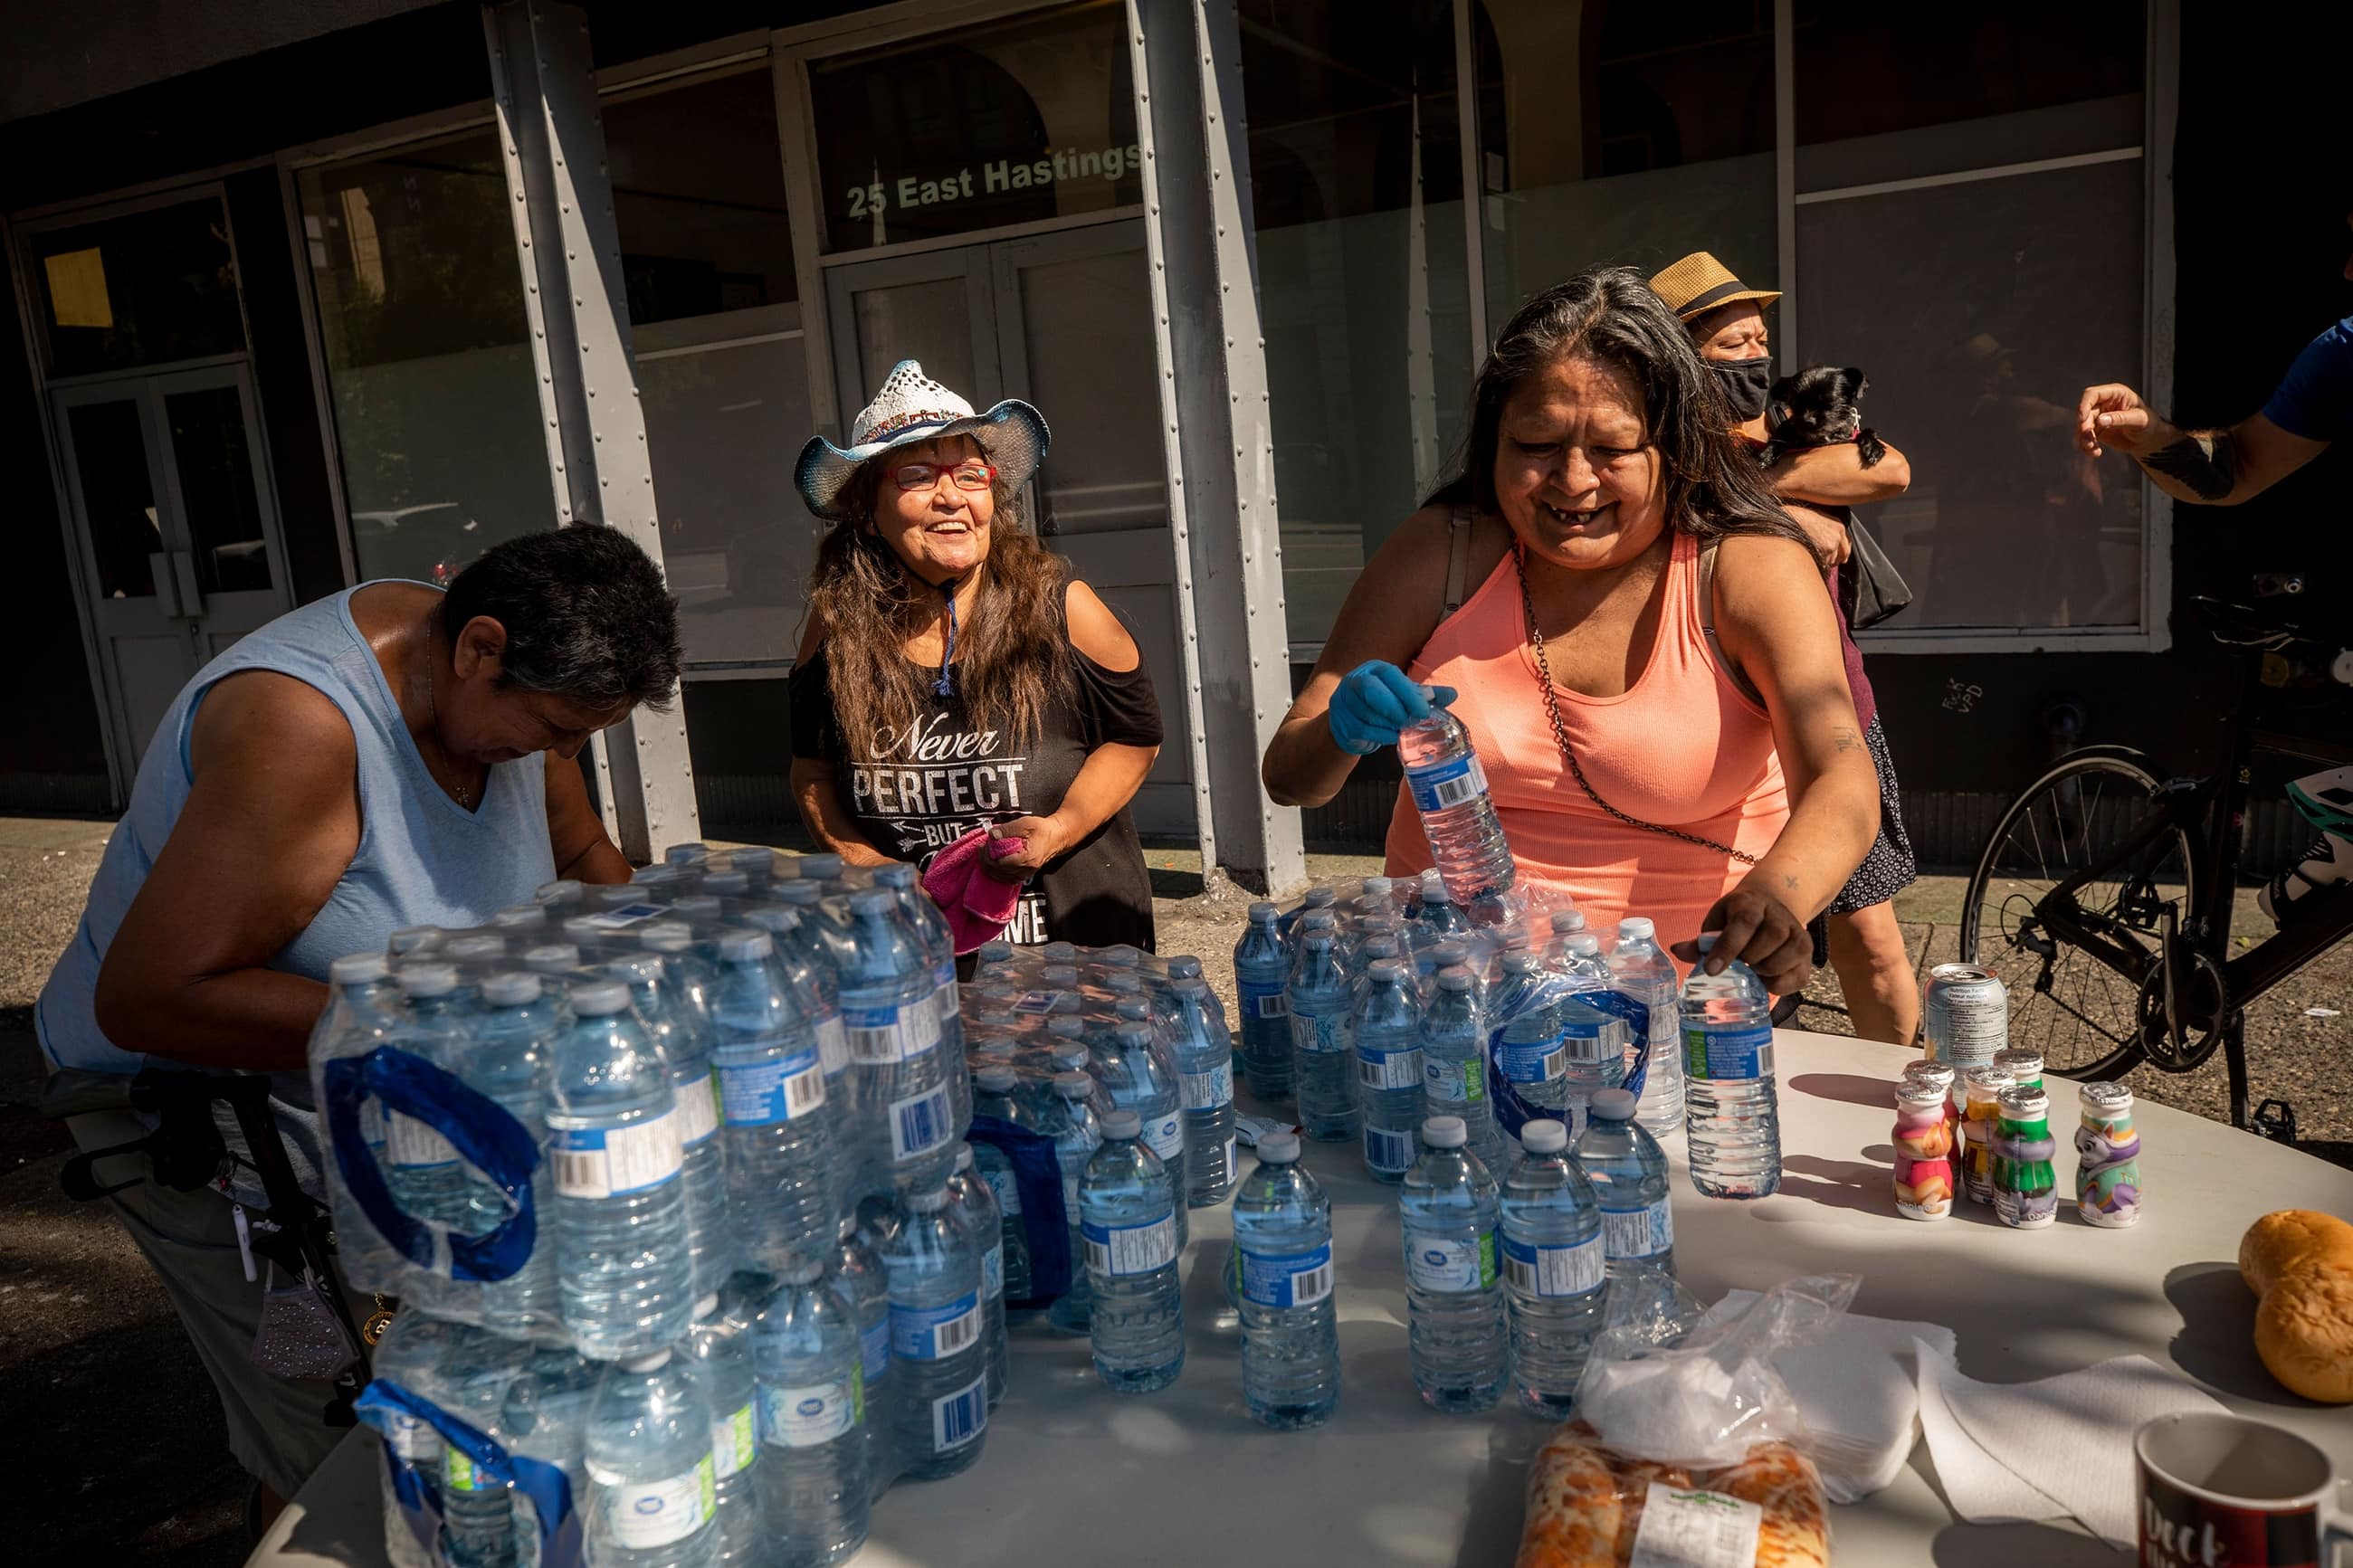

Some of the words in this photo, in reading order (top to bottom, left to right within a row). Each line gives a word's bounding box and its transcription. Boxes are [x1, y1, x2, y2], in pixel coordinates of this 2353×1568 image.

[847, 183, 888, 218] 25
[897, 167, 974, 209] East
[984, 143, 1142, 194] Hastings
[870, 711, 1000, 761] Never
[853, 764, 1024, 814] PERFECT
[924, 822, 963, 847] BUT
